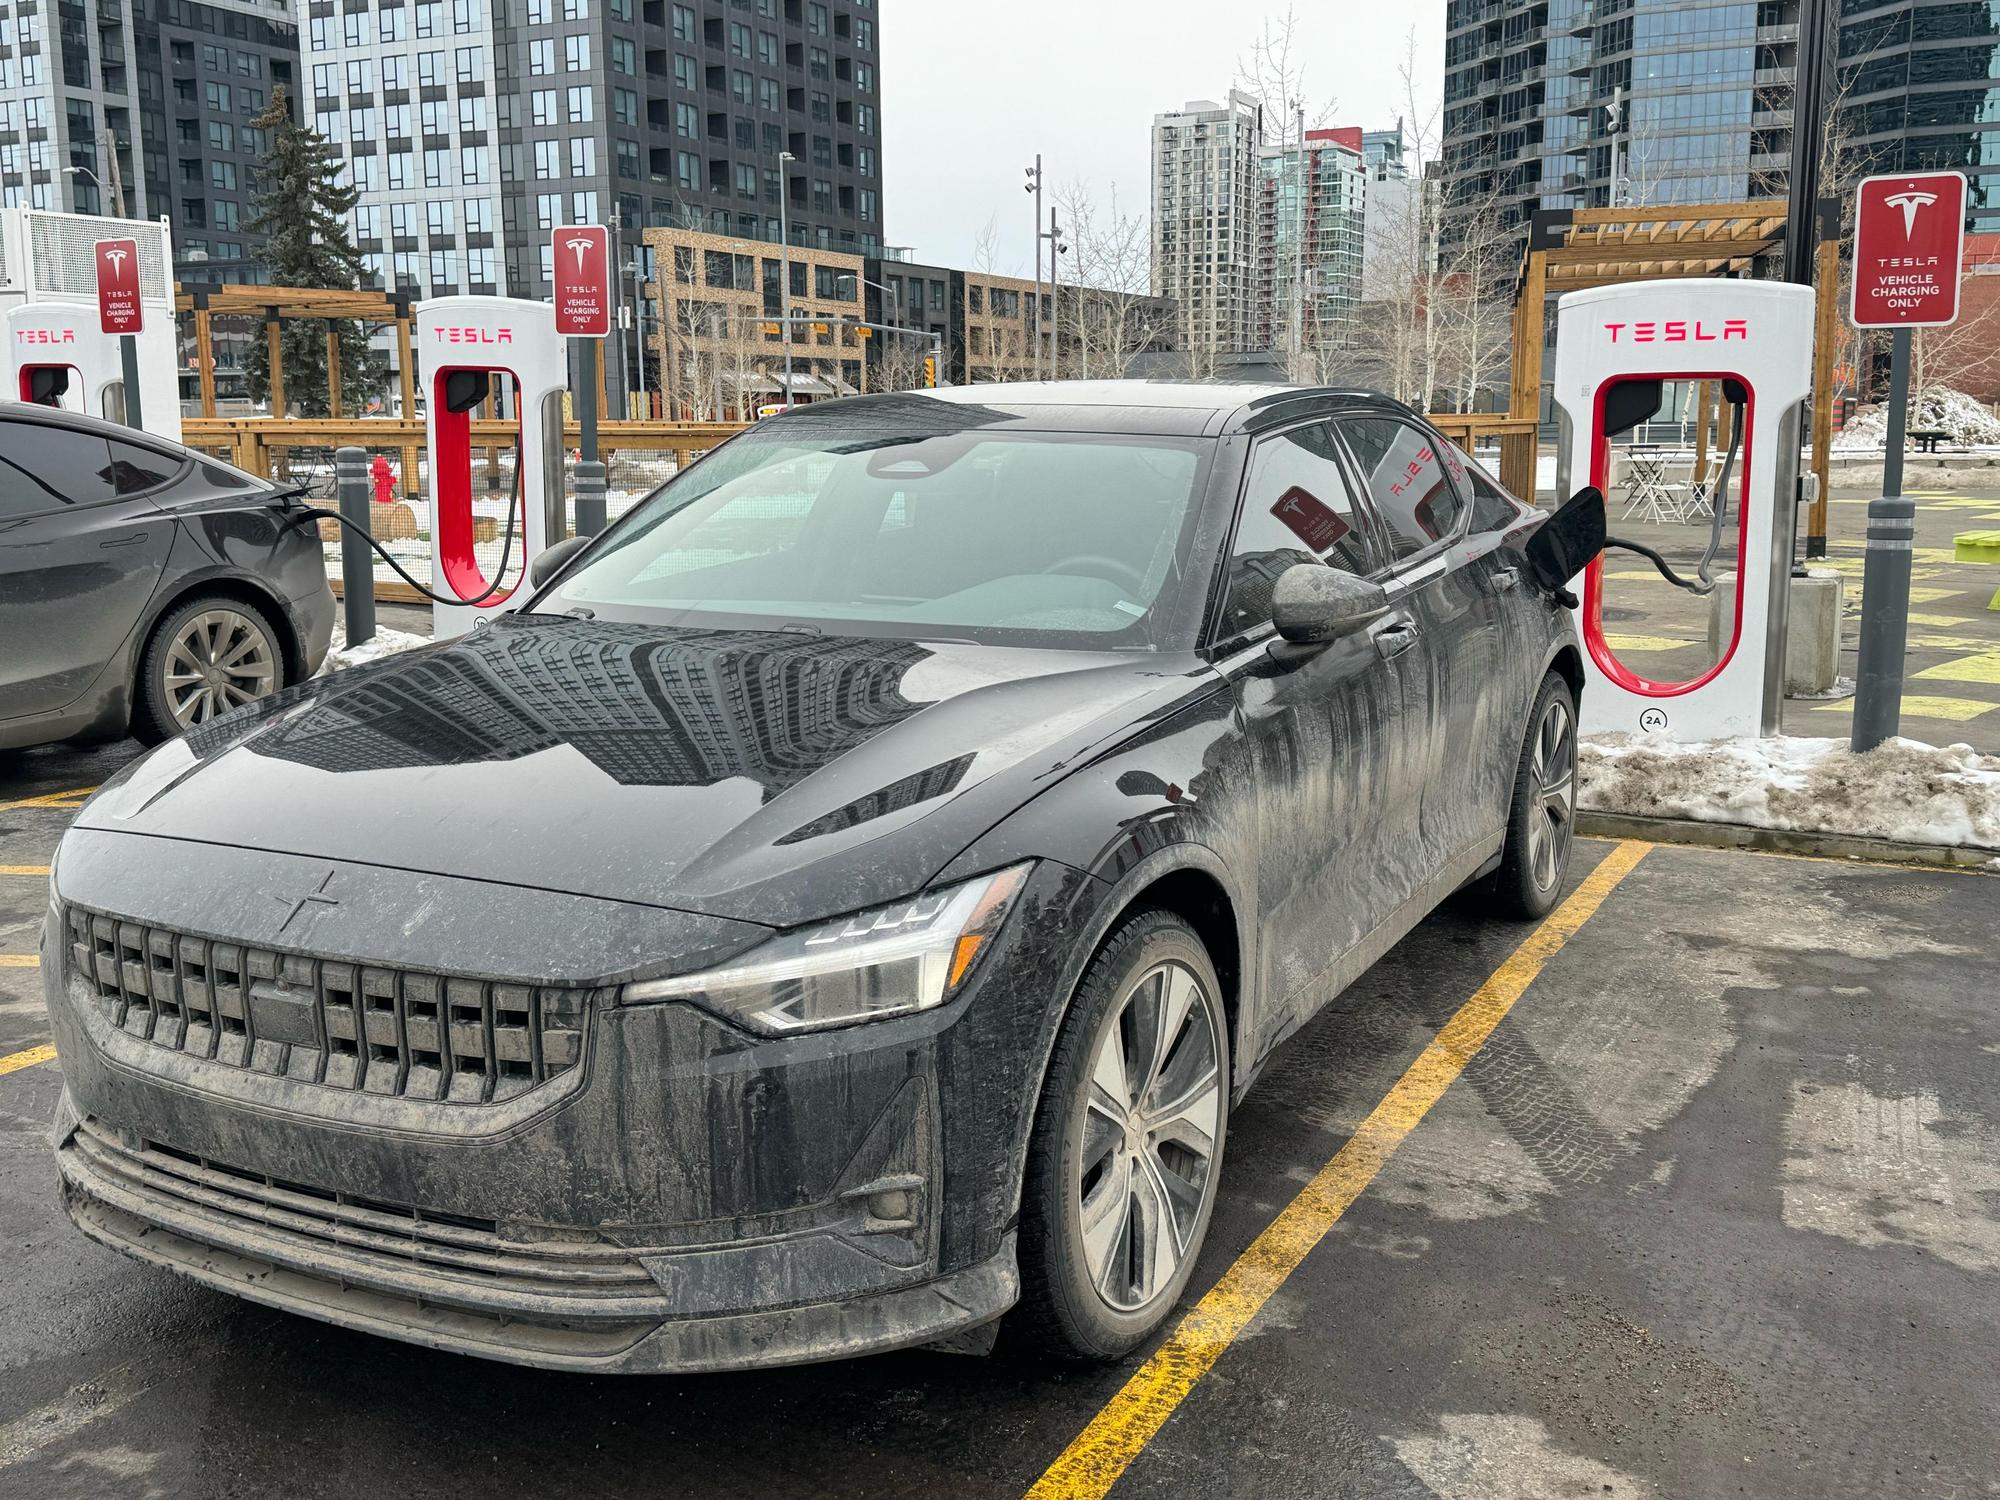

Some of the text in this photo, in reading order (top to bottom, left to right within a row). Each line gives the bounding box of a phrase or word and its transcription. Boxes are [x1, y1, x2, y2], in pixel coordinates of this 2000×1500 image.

[1878, 256, 1938, 268] TESLA
[1879, 274, 1934, 286] VEHICLE
[107, 290, 133, 299] TESLA
[565, 286, 598, 294] TESLA
[1871, 285, 1940, 298] CHARGING
[108, 302, 132, 310] VEHICLE
[567, 299, 596, 307] VEHICLE
[1887, 298, 1922, 309] ONLY
[106, 309, 136, 317] CHARGING
[563, 307, 600, 316] CHARGING
[114, 316, 129, 324] ONLY
[572, 315, 592, 324] ONLY
[1604, 319, 1747, 343] TESLA
[17, 330, 75, 345] TESLA
[434, 328, 512, 344] TESLA
[1645, 716, 1662, 726] 2A
